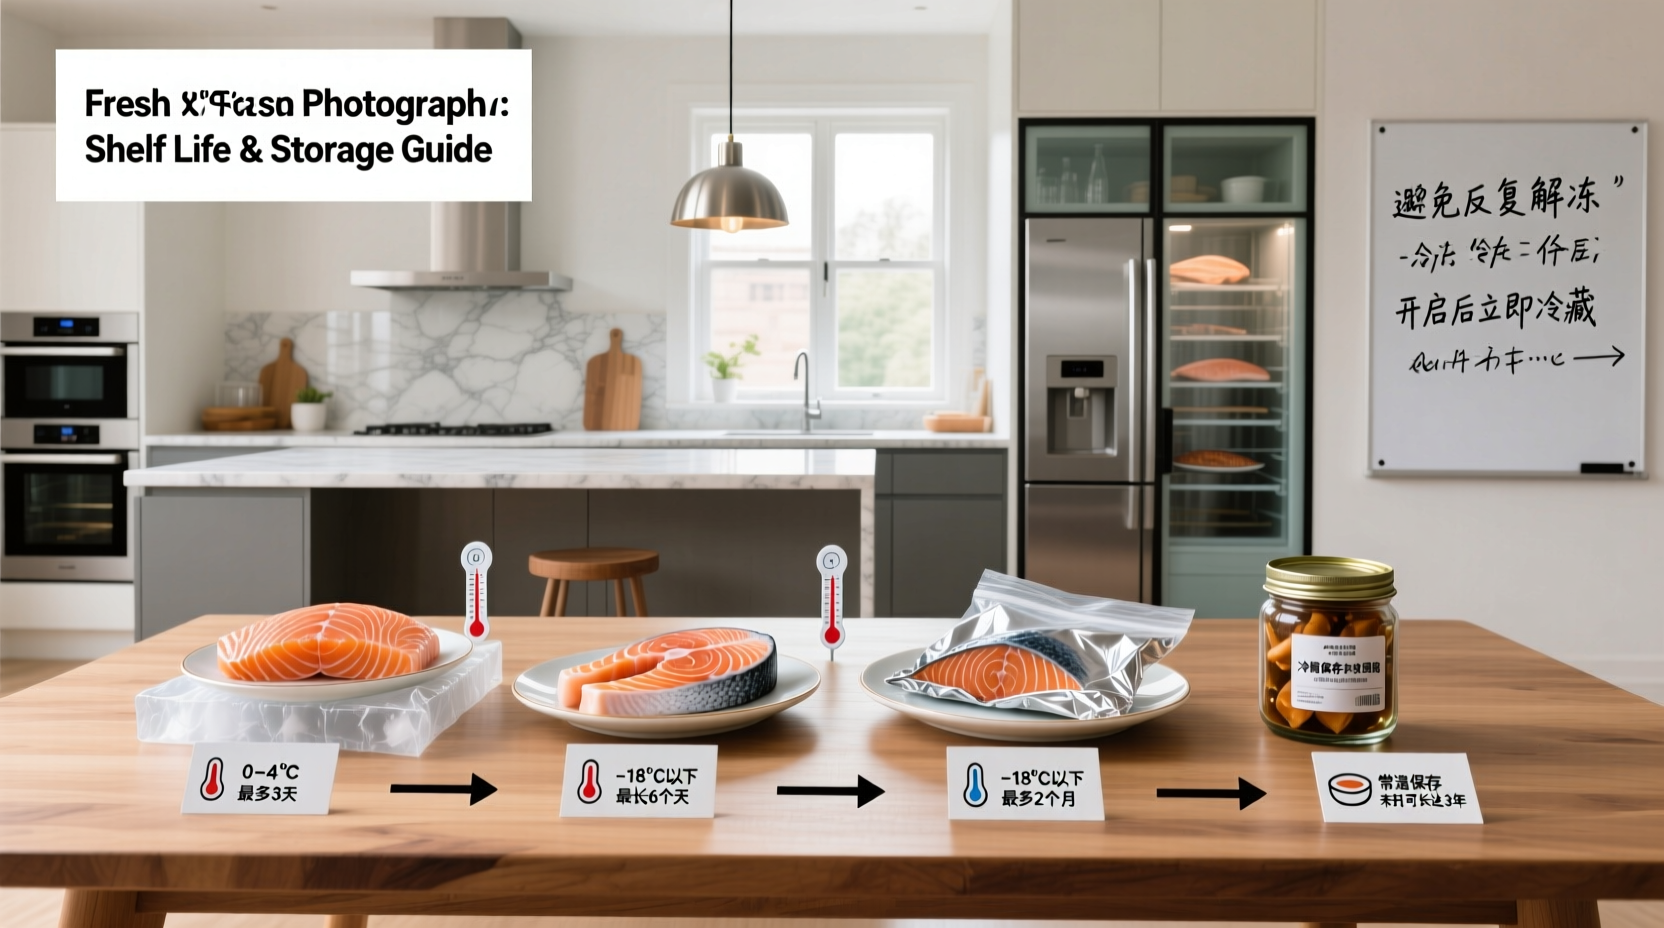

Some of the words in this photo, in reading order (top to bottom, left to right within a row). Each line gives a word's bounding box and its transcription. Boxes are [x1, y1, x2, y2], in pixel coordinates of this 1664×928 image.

[1395, 285, 1597, 331] 开启后立即冷藏
[236, 784, 298, 803] 最多3天
[615, 786, 690, 806] 最长6个天
[1001, 789, 1076, 808] 最多2个月
